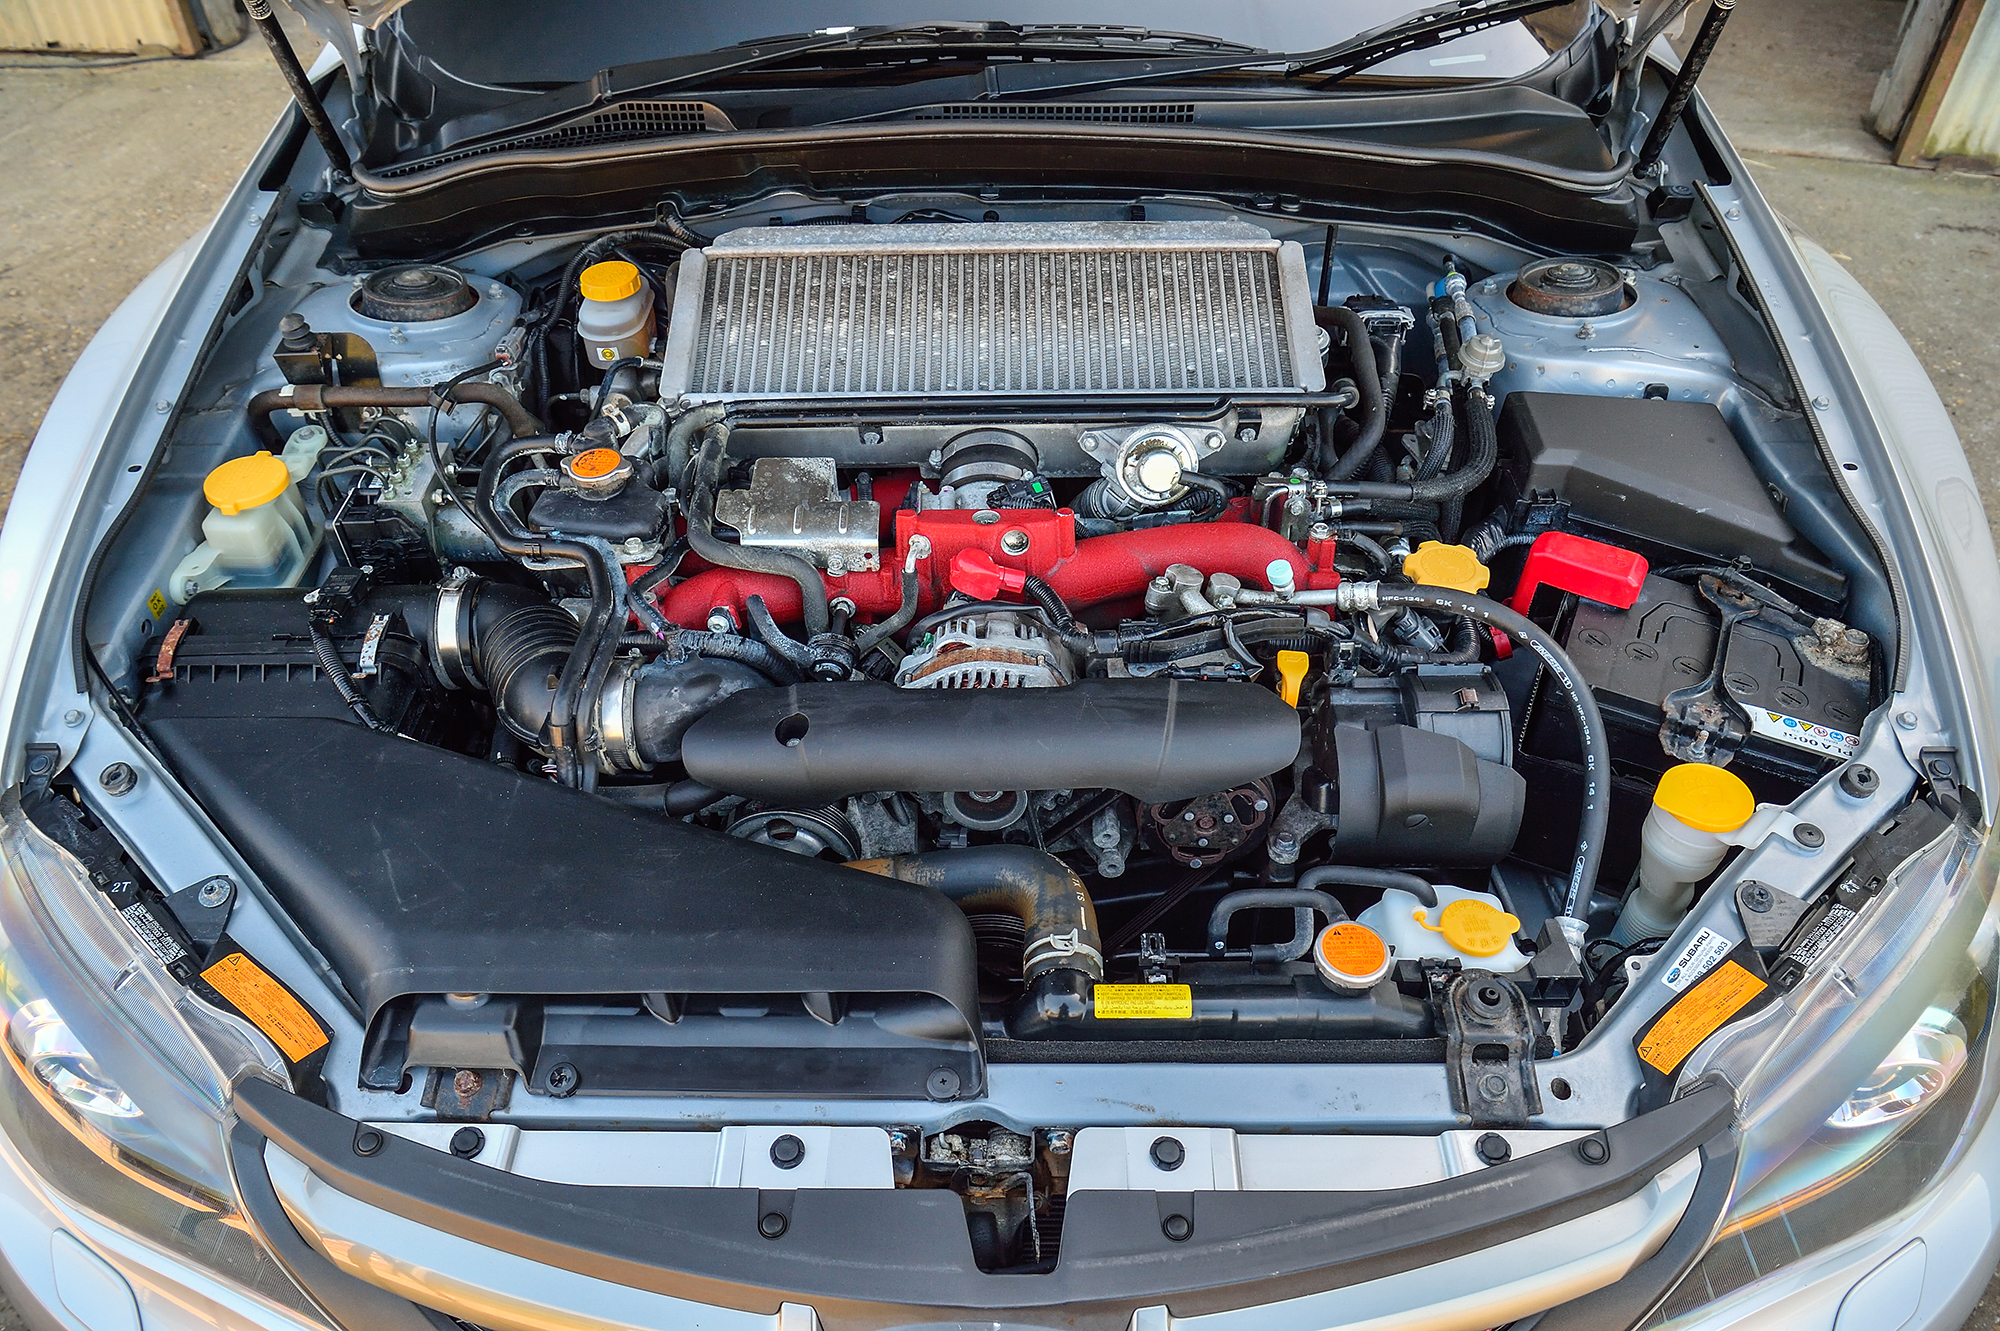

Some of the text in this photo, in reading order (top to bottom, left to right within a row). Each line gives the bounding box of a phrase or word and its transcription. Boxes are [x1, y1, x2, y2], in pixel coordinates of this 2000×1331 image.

[1436, 598, 1453, 607] GK
[1588, 754, 1595, 771] GK
[1588, 782, 1595, 796] 14
[111, 881, 132, 894] 2T
[1444, 900, 1498, 919] COOLANT
[1677, 930, 1710, 968] SUBARU
[1702, 954, 1716, 970] 502
[1713, 940, 1728, 956] 503
[1673, 978, 1681, 987] FOR
[1685, 960, 1695, 972] YOUR
[1693, 945, 1707, 962] GENUINE
